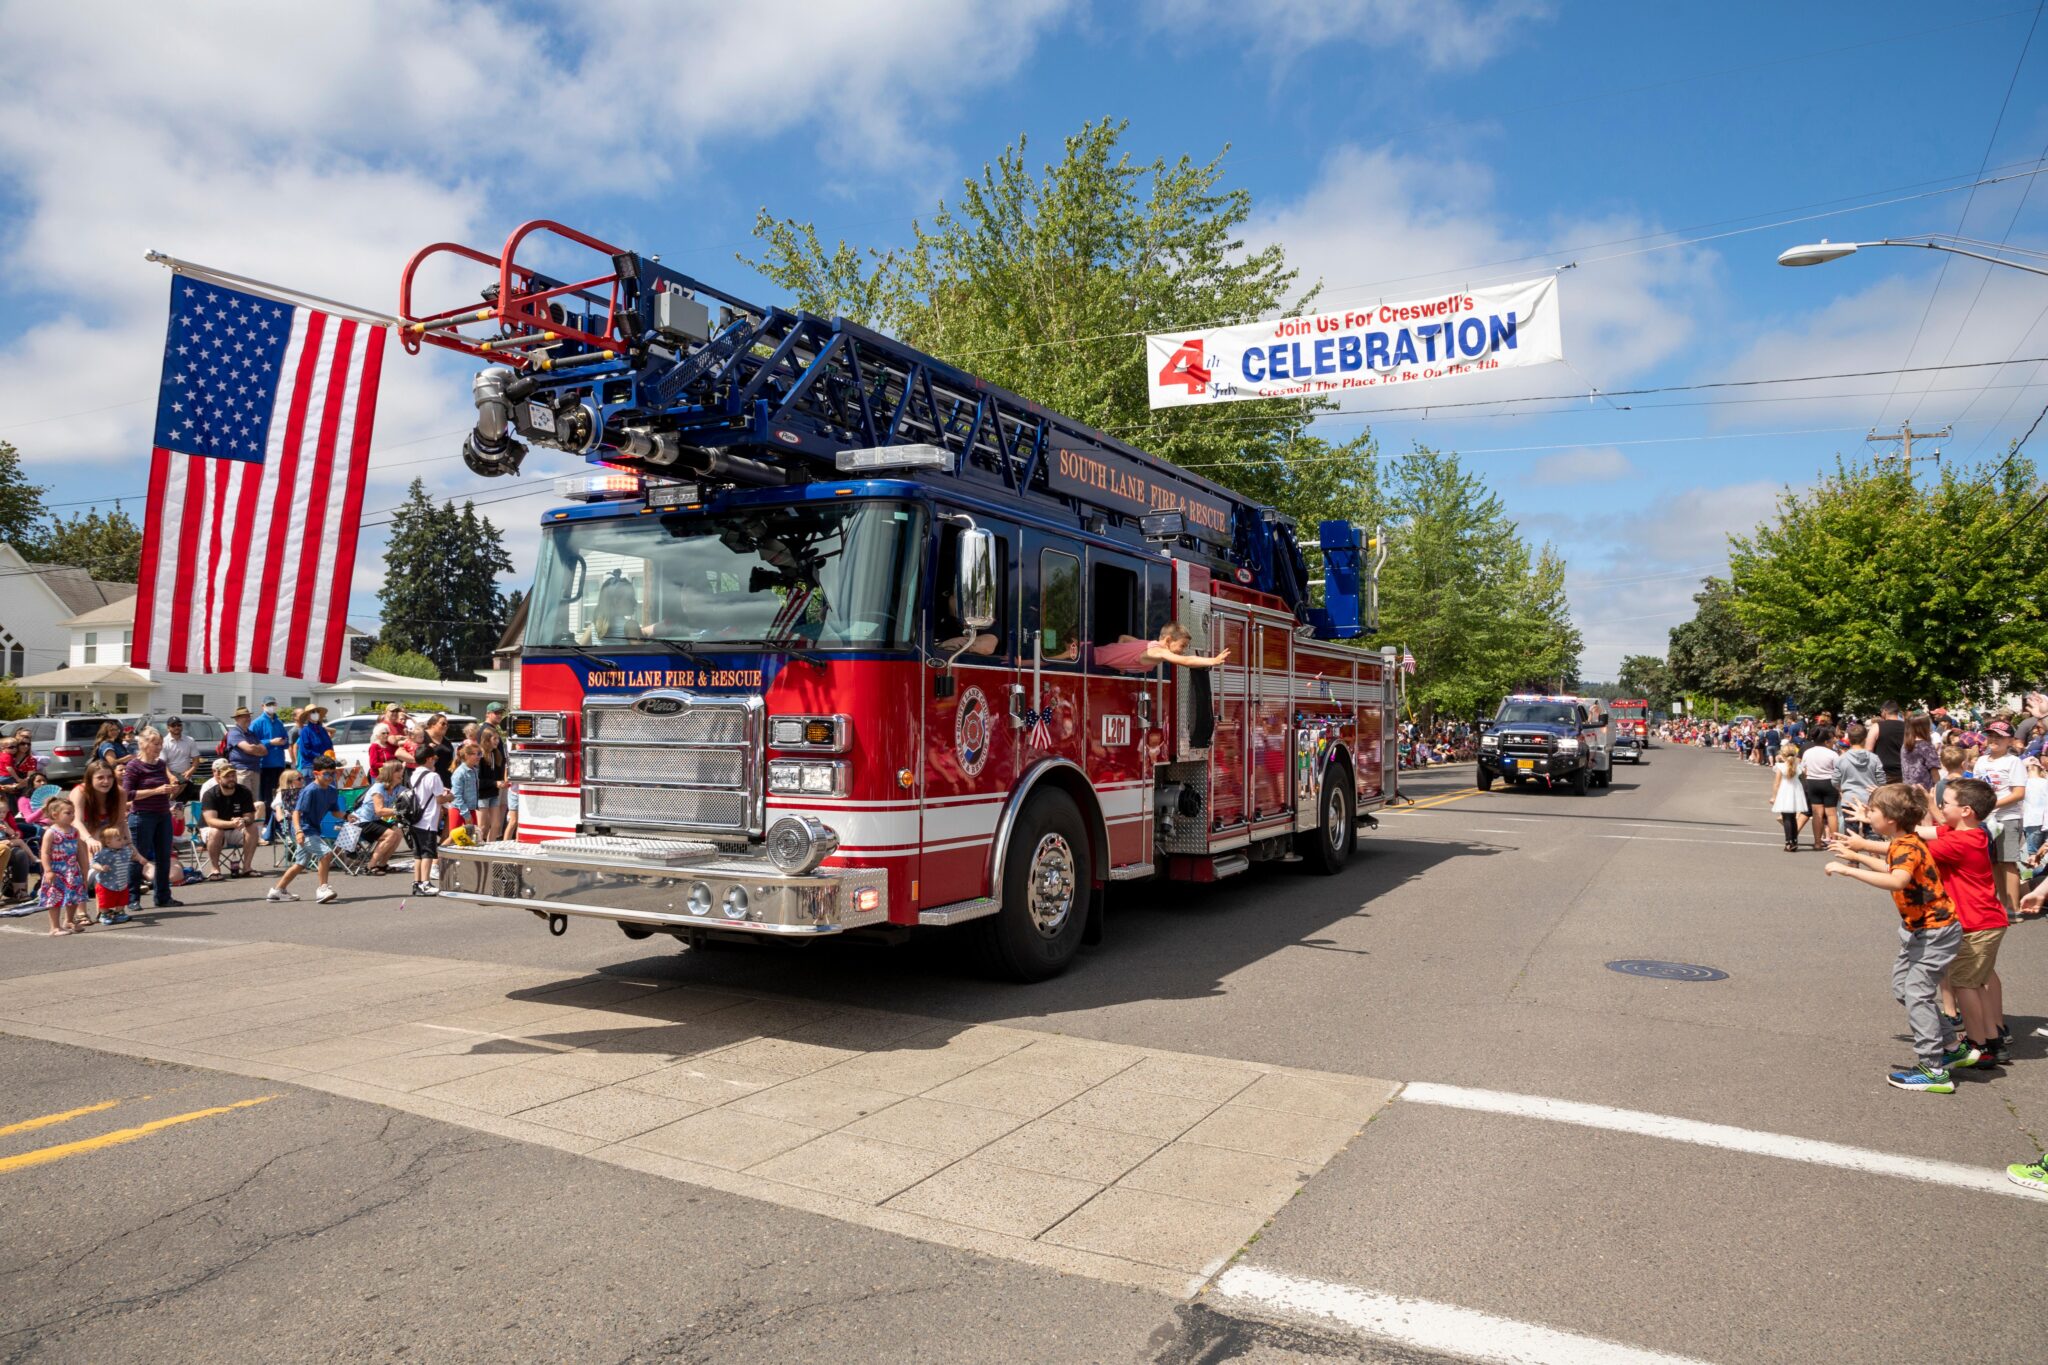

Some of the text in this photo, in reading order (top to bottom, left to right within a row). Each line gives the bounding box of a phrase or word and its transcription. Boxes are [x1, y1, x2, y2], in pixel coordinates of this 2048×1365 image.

[1274, 294, 1474, 338] Join Us For Creswell's
[1242, 312, 1518, 383] CELEBRATION
[1258, 383, 1311, 397] Creswell
[1316, 381, 1338, 391] The
[1342, 378, 1376, 388] Place
[1381, 373, 1397, 383] To
[1402, 371, 1418, 381] Be
[1447, 364, 1471, 375] The
[1476, 359, 1499, 370] 4th
[1060, 448, 1226, 532] SOUTH LANE FIRE & RESCUE
[588, 670, 762, 687] SOUTH LANE FIRE & RESCUE
[1106, 717, 1126, 743] L201
